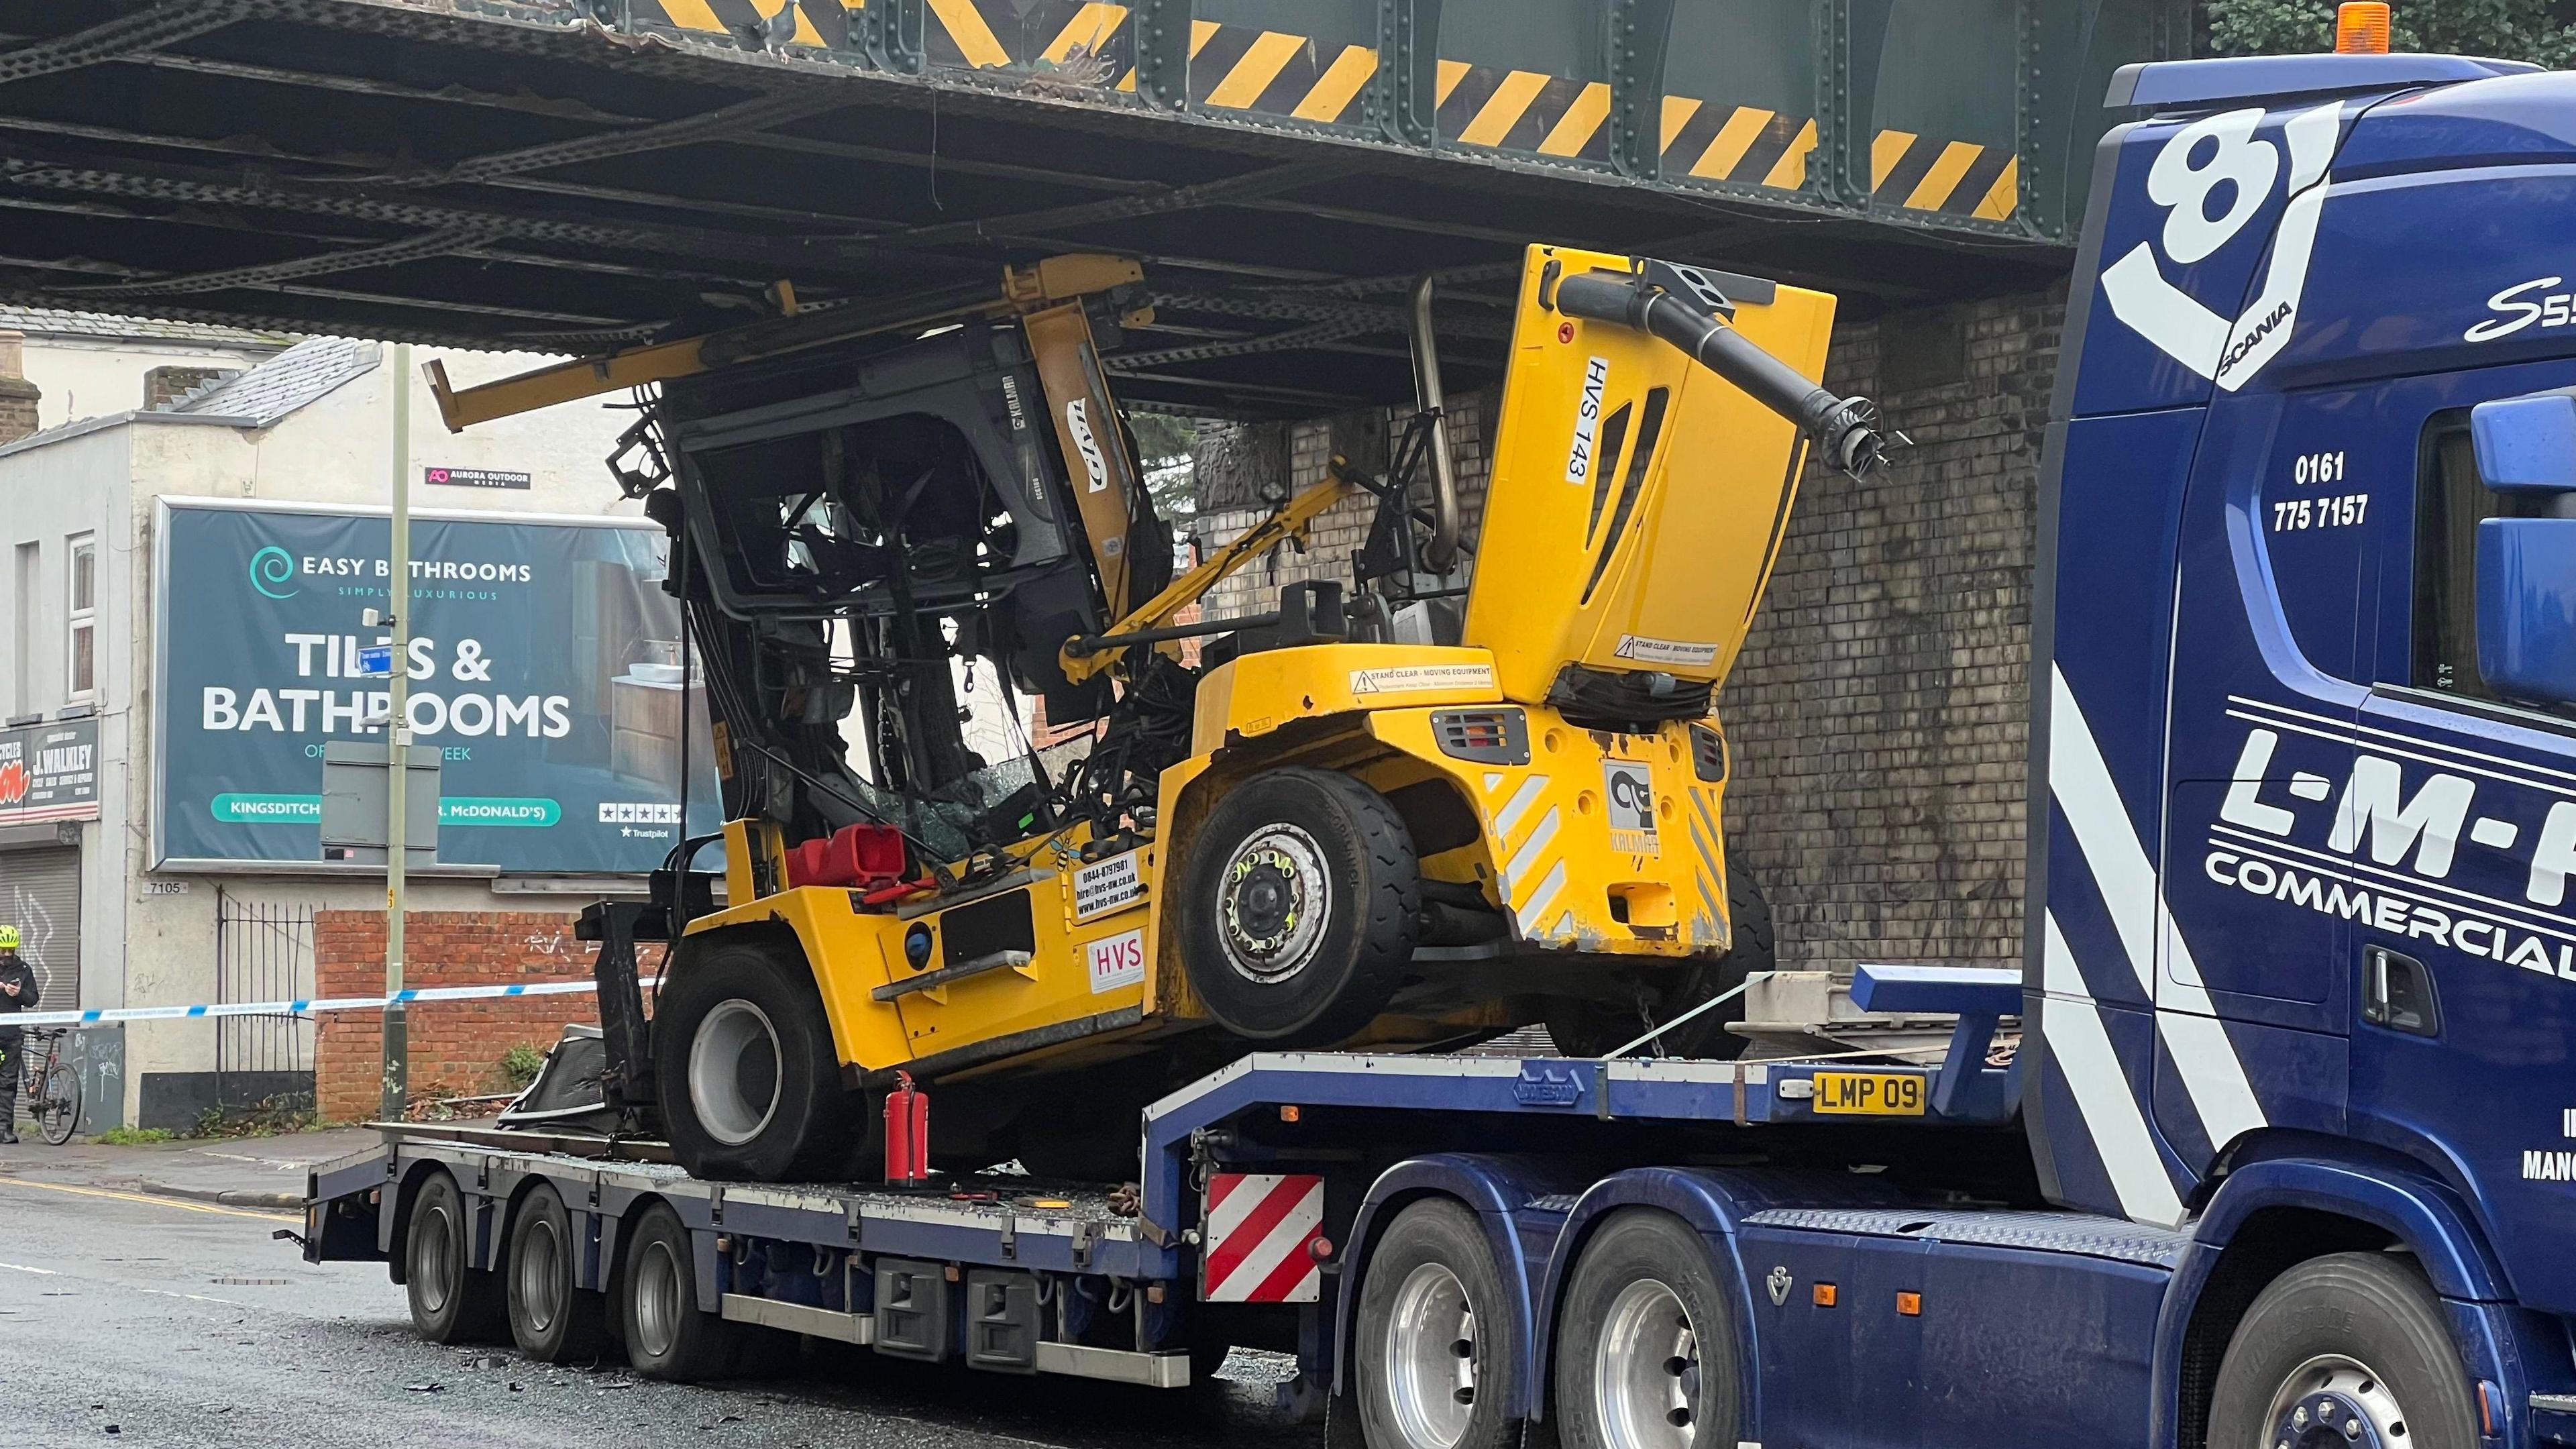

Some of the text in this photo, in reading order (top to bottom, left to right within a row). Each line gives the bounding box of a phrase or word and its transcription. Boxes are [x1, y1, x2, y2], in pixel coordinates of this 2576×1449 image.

[2464, 276, 2576, 343] S5
[2220, 301, 2293, 378] SCANIA
[1569, 360, 1606, 477] HVS 143
[450, 470, 486, 479] AURORA
[488, 472, 528, 482] OUTDOOR
[2296, 451, 2344, 484] 0161
[2275, 494, 2368, 531] 775 7157
[302, 556, 531, 582] EASY BTHROOMS
[407, 589, 498, 601] UXURIOUS
[1635, 640, 1652, 648] STAND
[1653, 643, 1670, 651] CLEAR
[451, 639, 492, 682] &
[1371, 671, 1394, 680] STAND
[1396, 670, 1418, 678] CLEAR
[1452, 667, 1490, 676] EQUIPMENT
[440, 747, 471, 761] EEK
[230, 802, 320, 815] KINGSDITCH
[451, 805, 546, 820] McDONALD'S)
[633, 828, 669, 839] Trustpilot
[1610, 833, 1659, 854] KALMAR
[1083, 859, 1128, 883] 0844-8797981
[150, 883, 180, 893] 7105
[1077, 872, 1136, 900] hire@hvs-nw.co.uk
[1097, 938, 1141, 975] HVS
[1821, 1078, 1917, 1108] LMP 09
[2522, 1150, 2576, 1181] MAN
